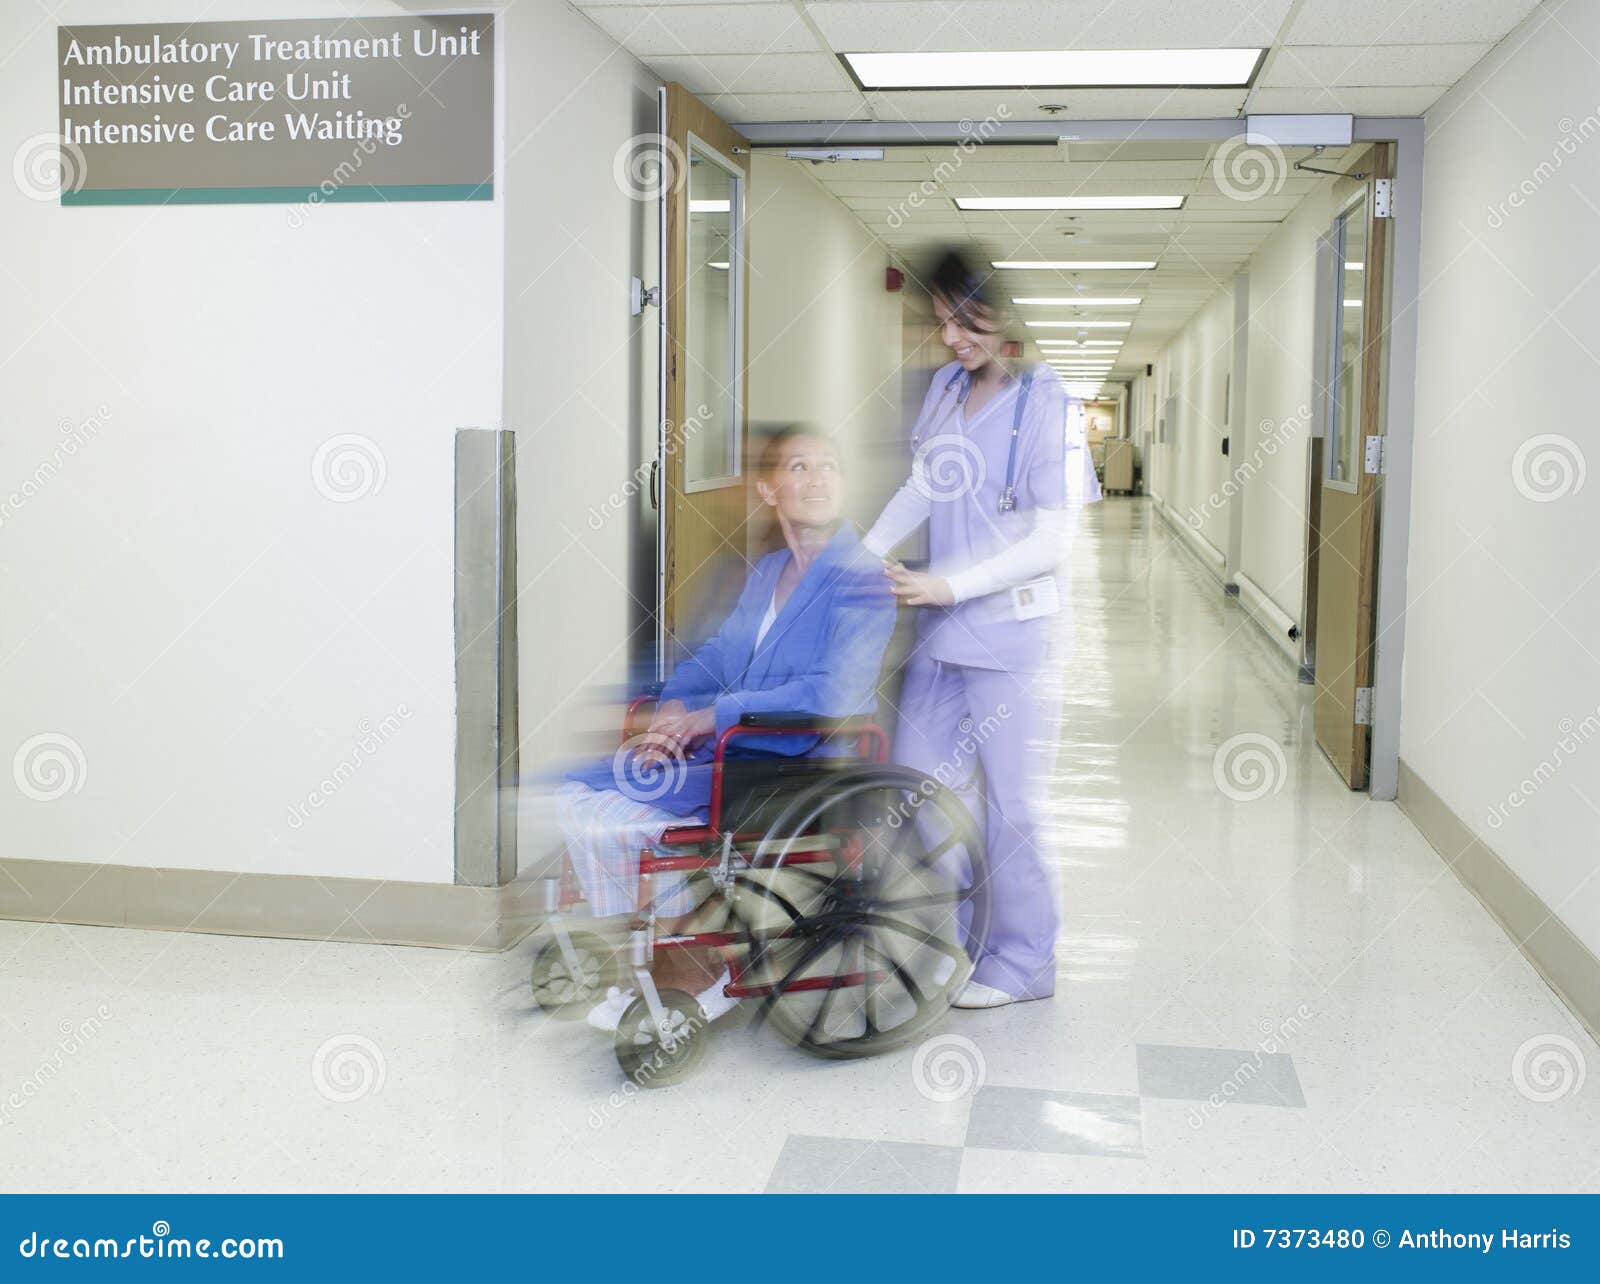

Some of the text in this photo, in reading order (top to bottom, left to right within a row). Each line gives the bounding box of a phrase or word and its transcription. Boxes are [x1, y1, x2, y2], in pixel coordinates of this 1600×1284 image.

[63, 26, 480, 68] Ambulatory Treatment Unit
[63, 70, 352, 105] Intensive Care Unit
[63, 111, 403, 146] Intensive Care Waiting
